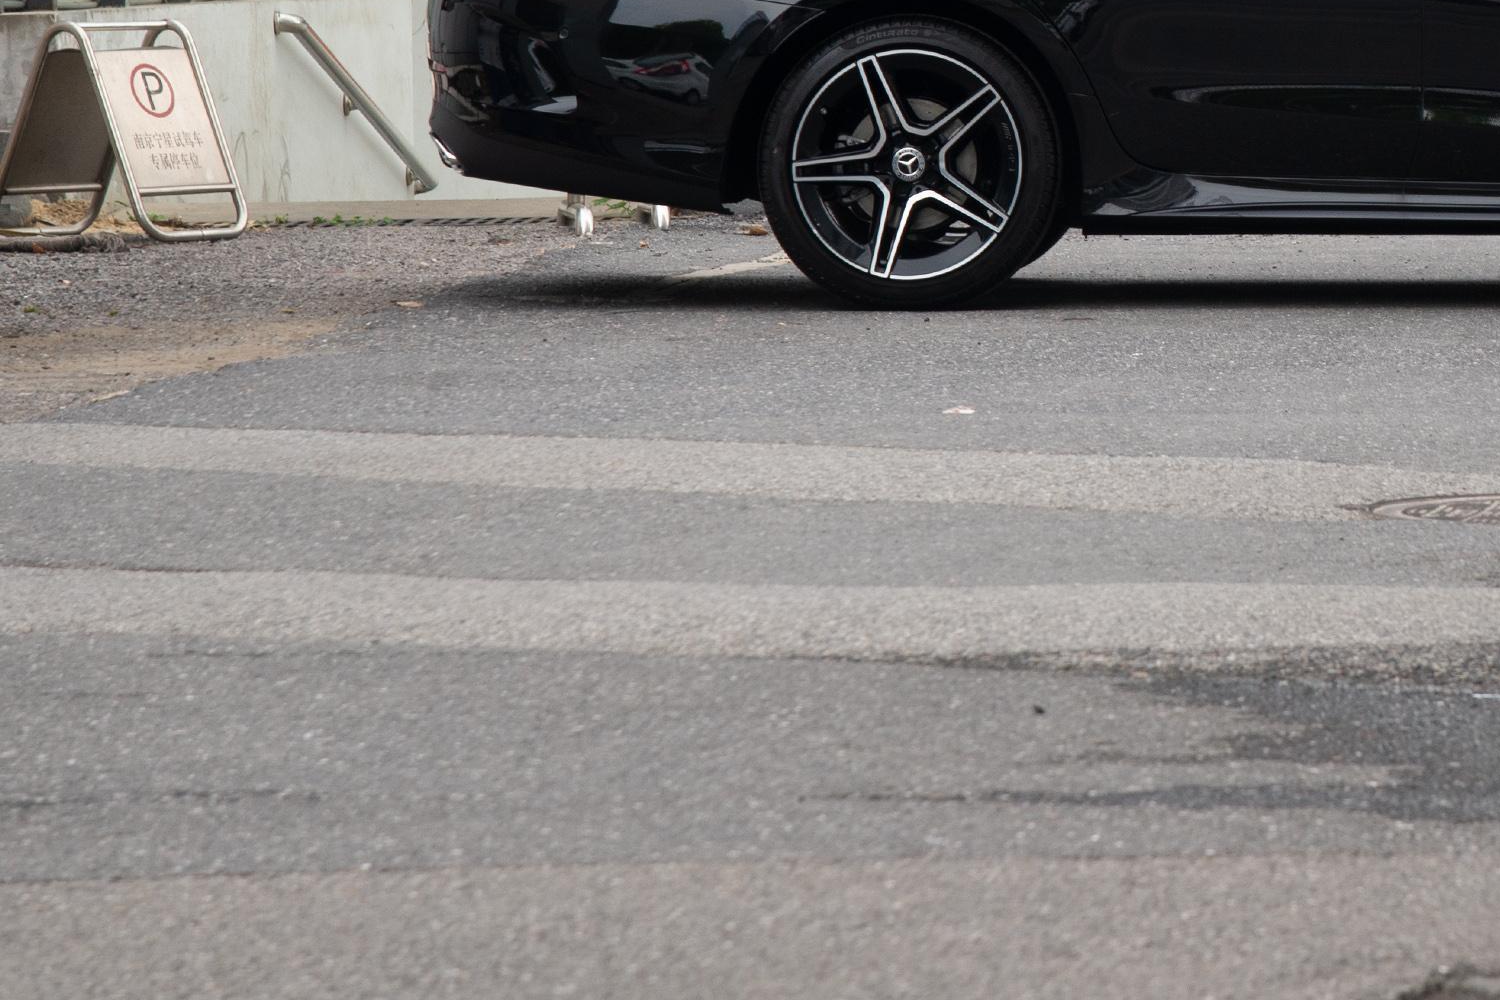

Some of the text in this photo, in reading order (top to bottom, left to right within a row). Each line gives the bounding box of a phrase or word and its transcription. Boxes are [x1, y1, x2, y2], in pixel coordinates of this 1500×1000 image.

[141, 71, 163, 110] P
[150, 151, 202, 170] 专属停车位
